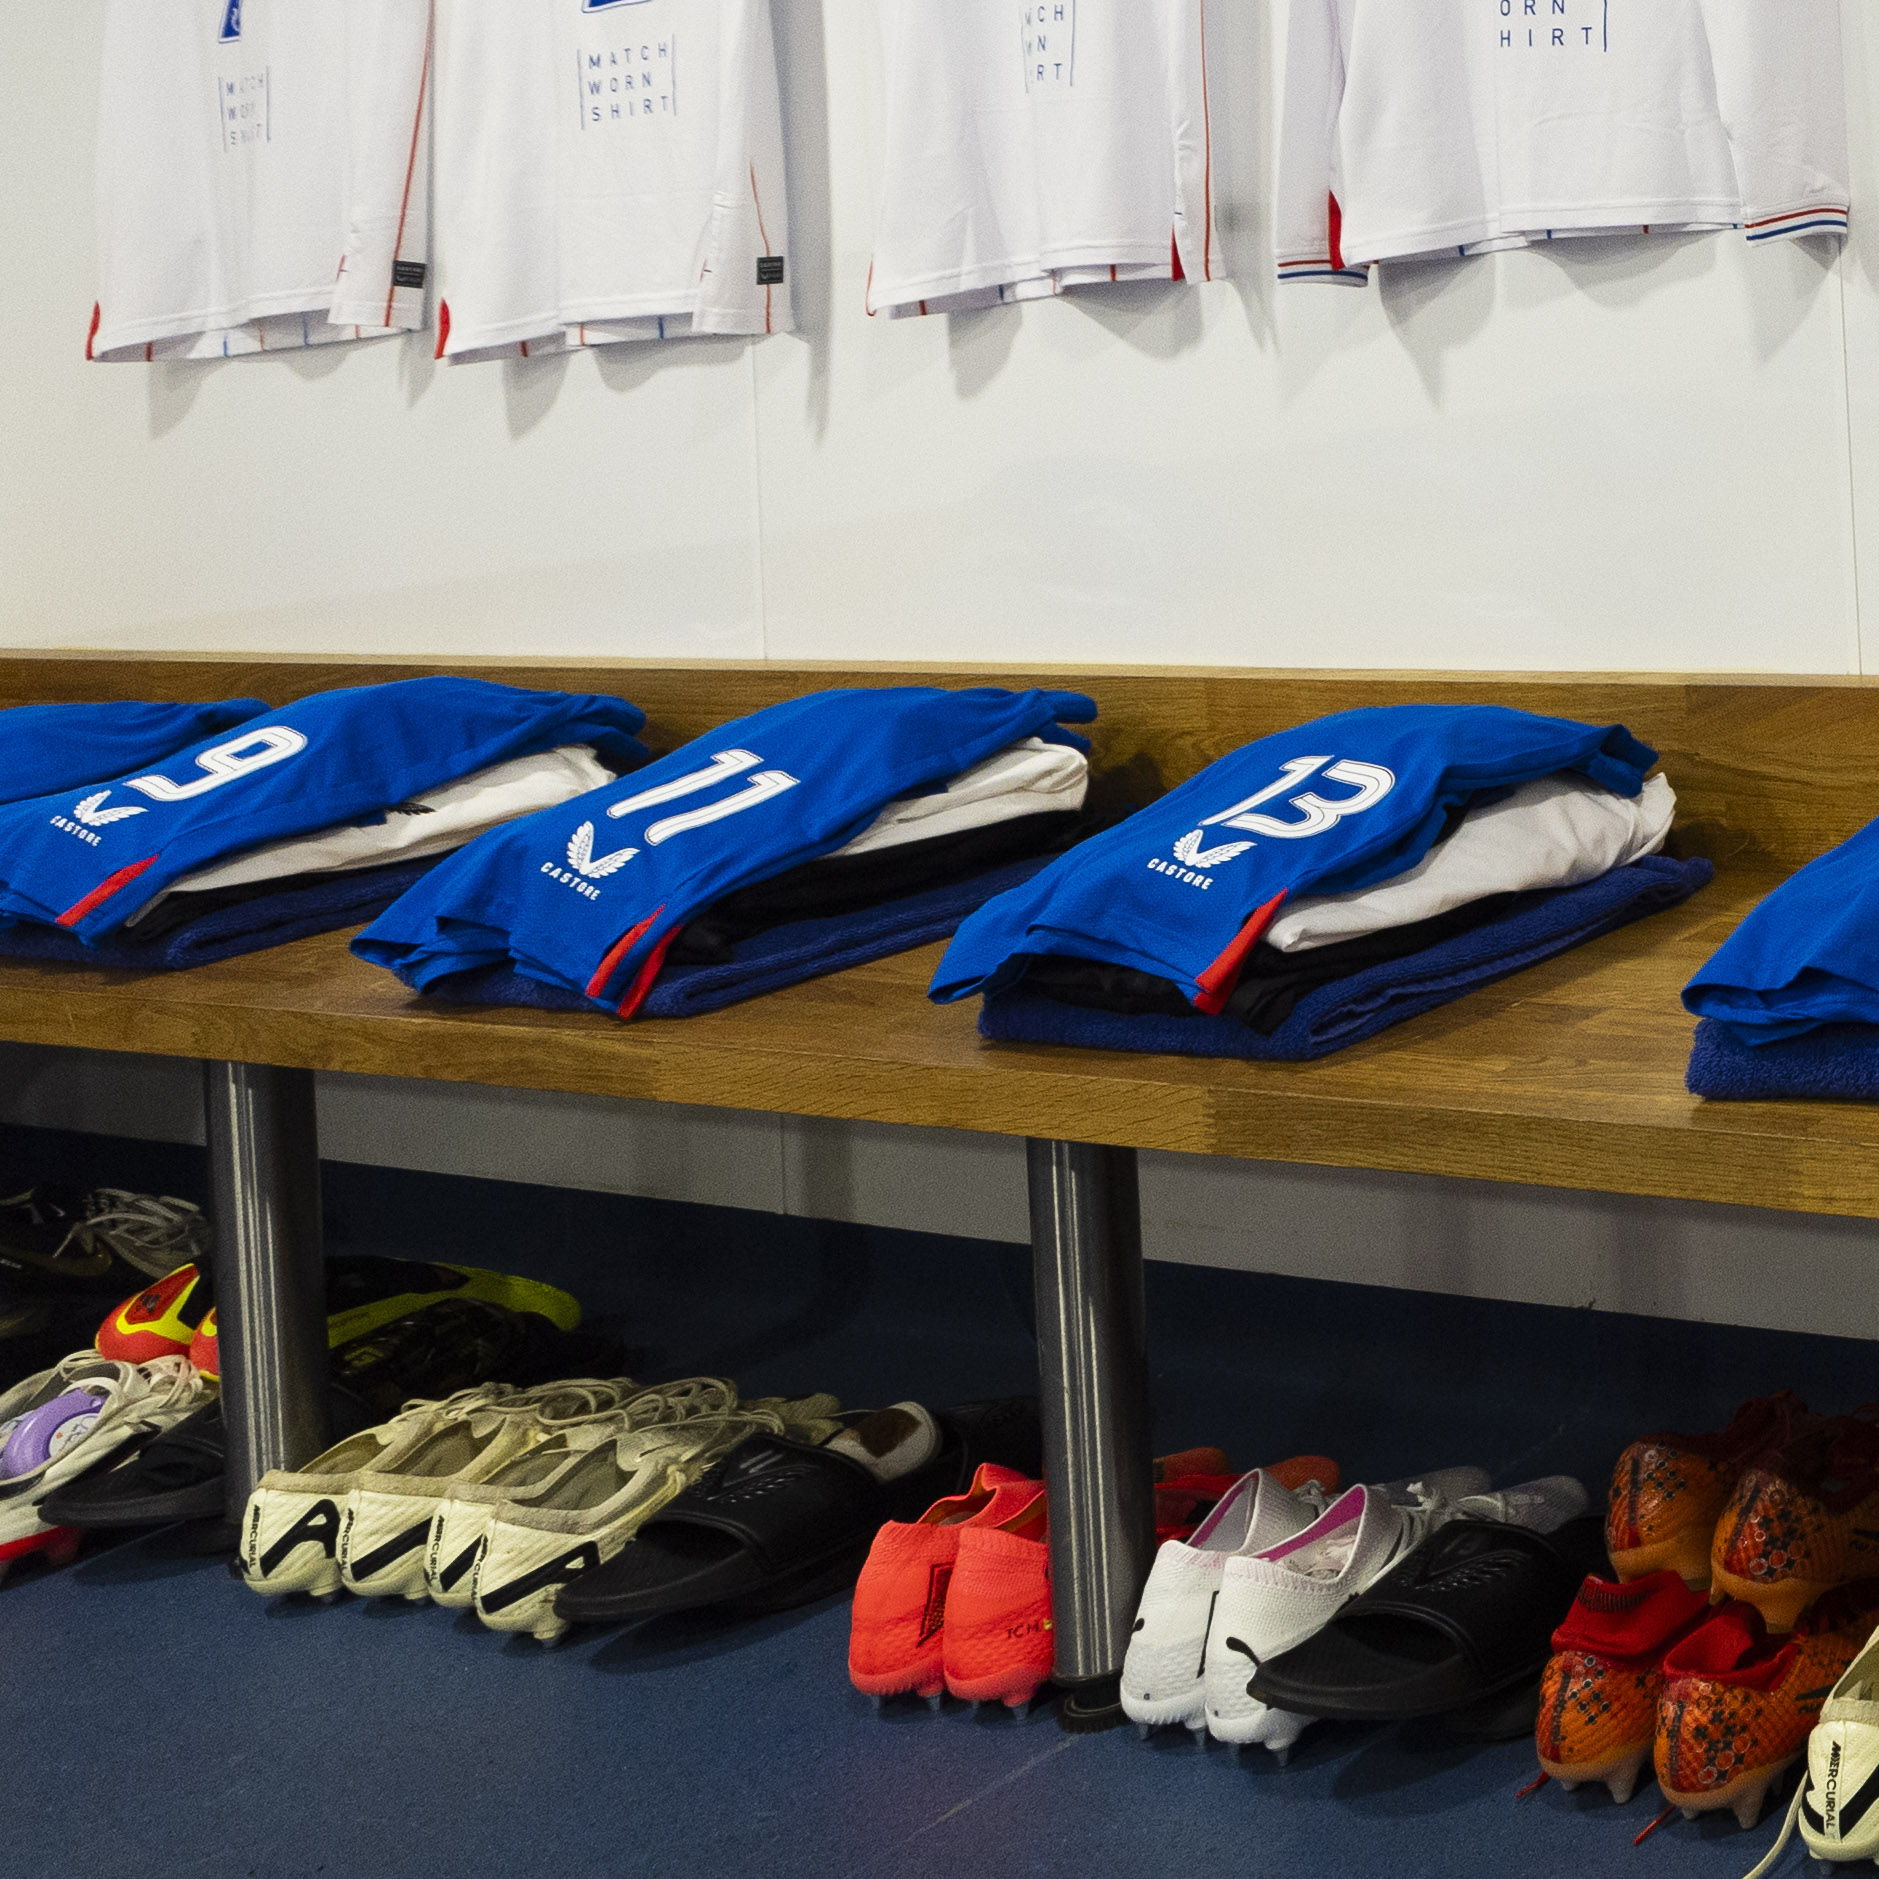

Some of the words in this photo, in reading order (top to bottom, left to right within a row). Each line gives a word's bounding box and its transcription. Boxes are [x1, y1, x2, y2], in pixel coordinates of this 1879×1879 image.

[1500, 26, 1593, 47] HIRT
[588, 42, 667, 69] MATCH
[588, 71, 652, 95] WORN
[591, 96, 669, 122] SHIRT
[122, 725, 309, 802] 9
[606, 748, 801, 846] 11
[1197, 754, 1396, 839] 13
[50, 815, 102, 847] CASTORE
[540, 862, 600, 901] CASTORE
[1147, 858, 1214, 891] CASTORE
[244, 1504, 261, 1568] MERCURIAL
[1825, 1740, 1842, 1829] MERCURIAL
